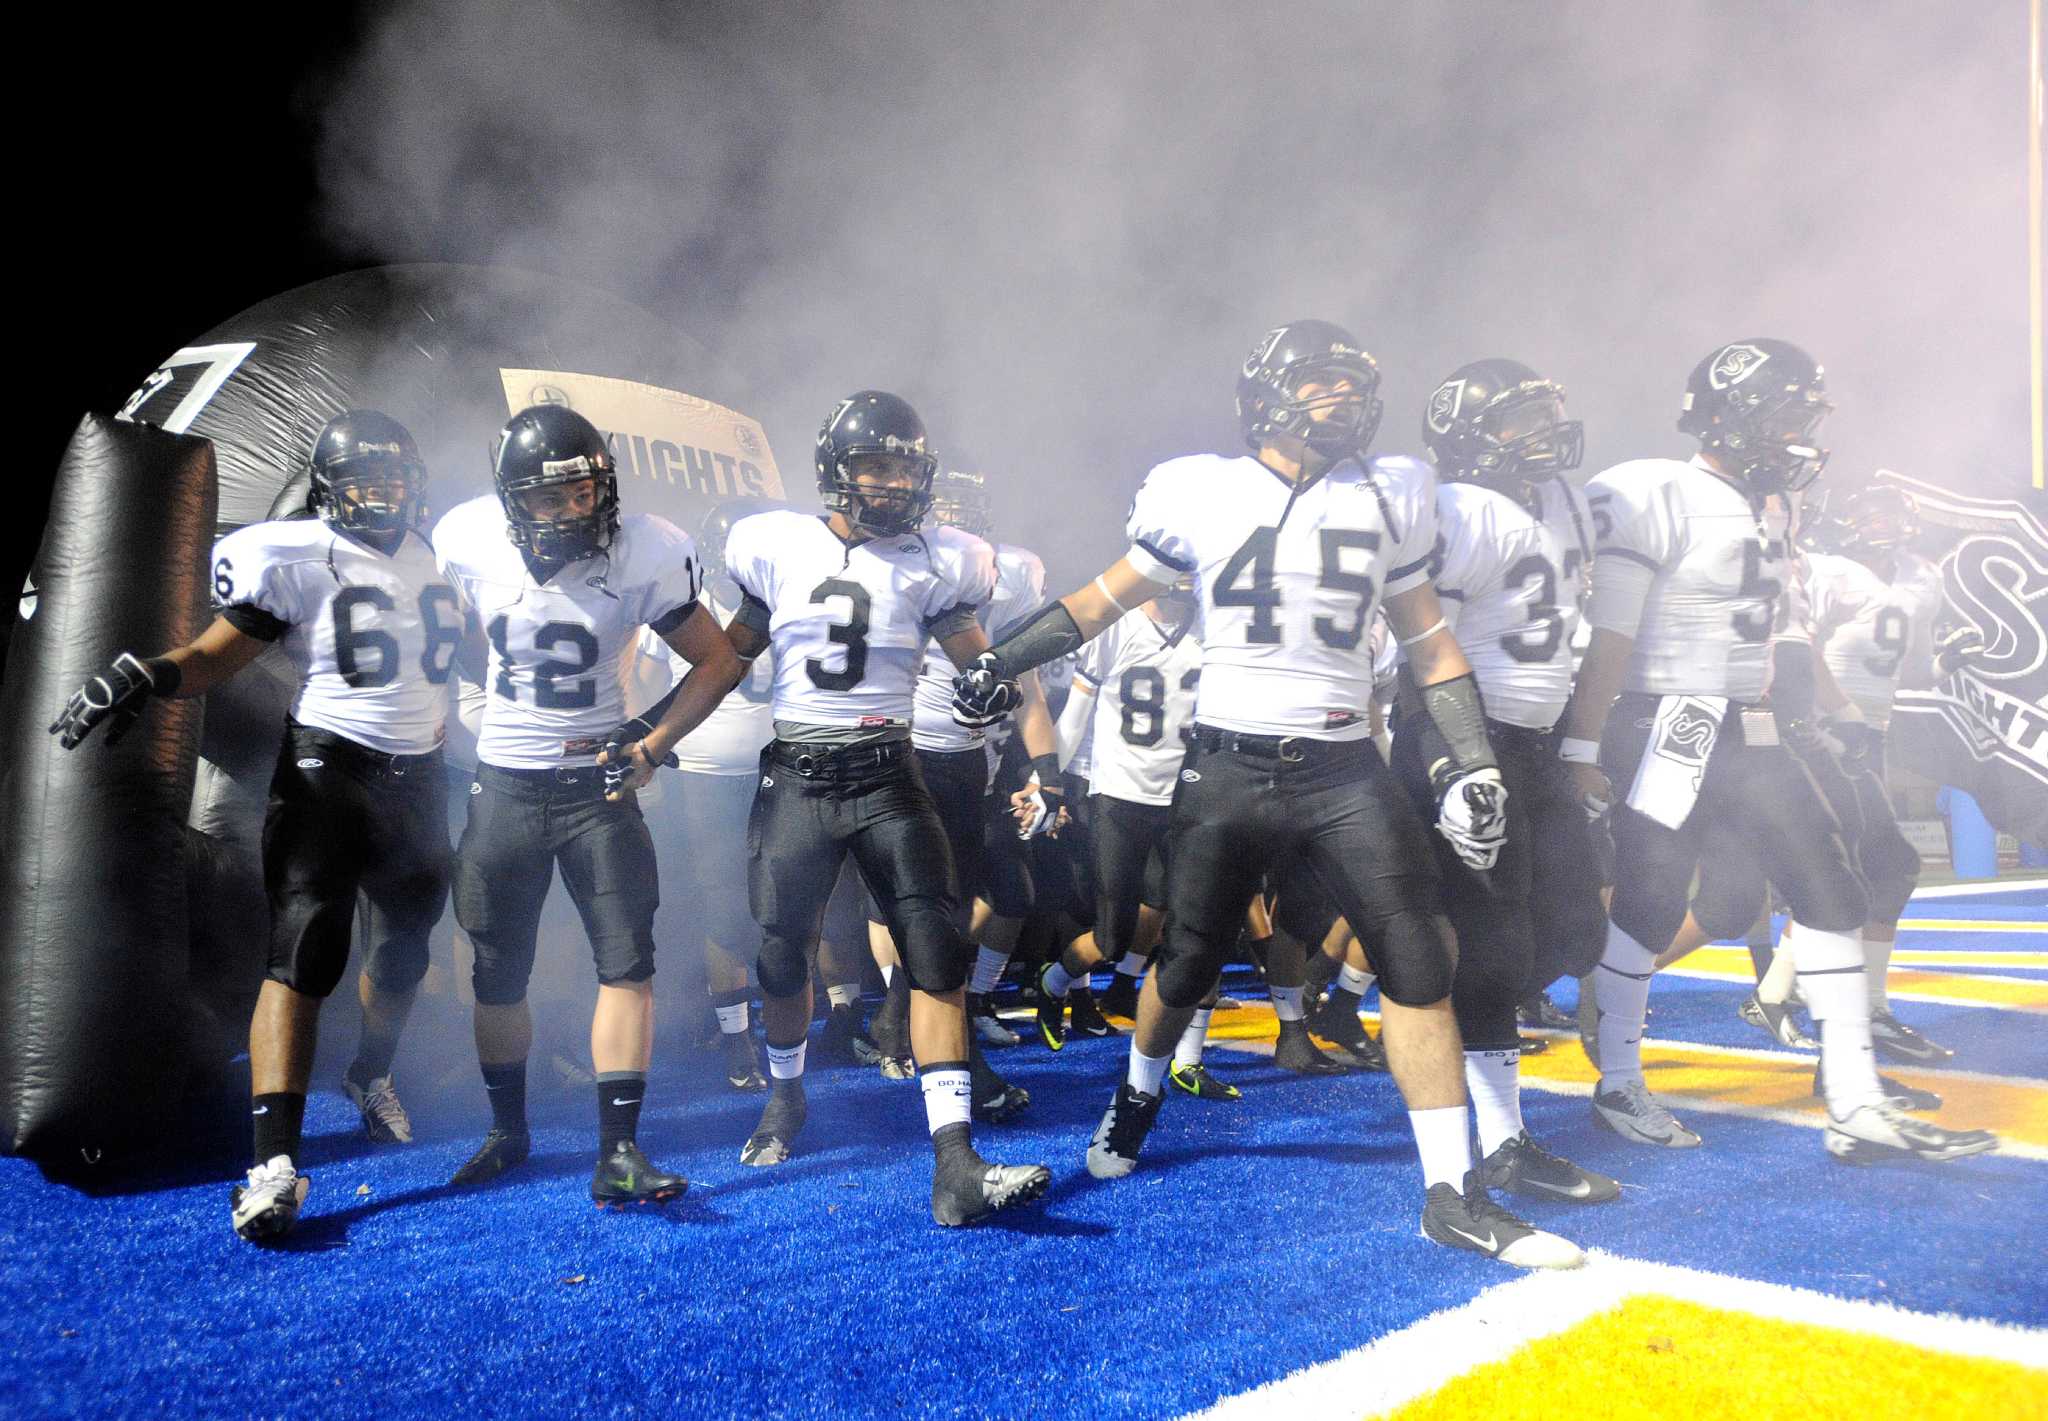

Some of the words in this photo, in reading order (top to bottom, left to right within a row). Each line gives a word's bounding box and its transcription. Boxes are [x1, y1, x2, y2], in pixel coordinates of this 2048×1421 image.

[598, 428, 769, 499] NIGHTS
[213, 557, 234, 599] 6
[1211, 525, 1382, 651] 45
[1732, 537, 1783, 642] 5
[333, 584, 463, 688] 66
[487, 614, 600, 709] 12
[804, 576, 872, 692] 3
[1865, 605, 1909, 677] 9
